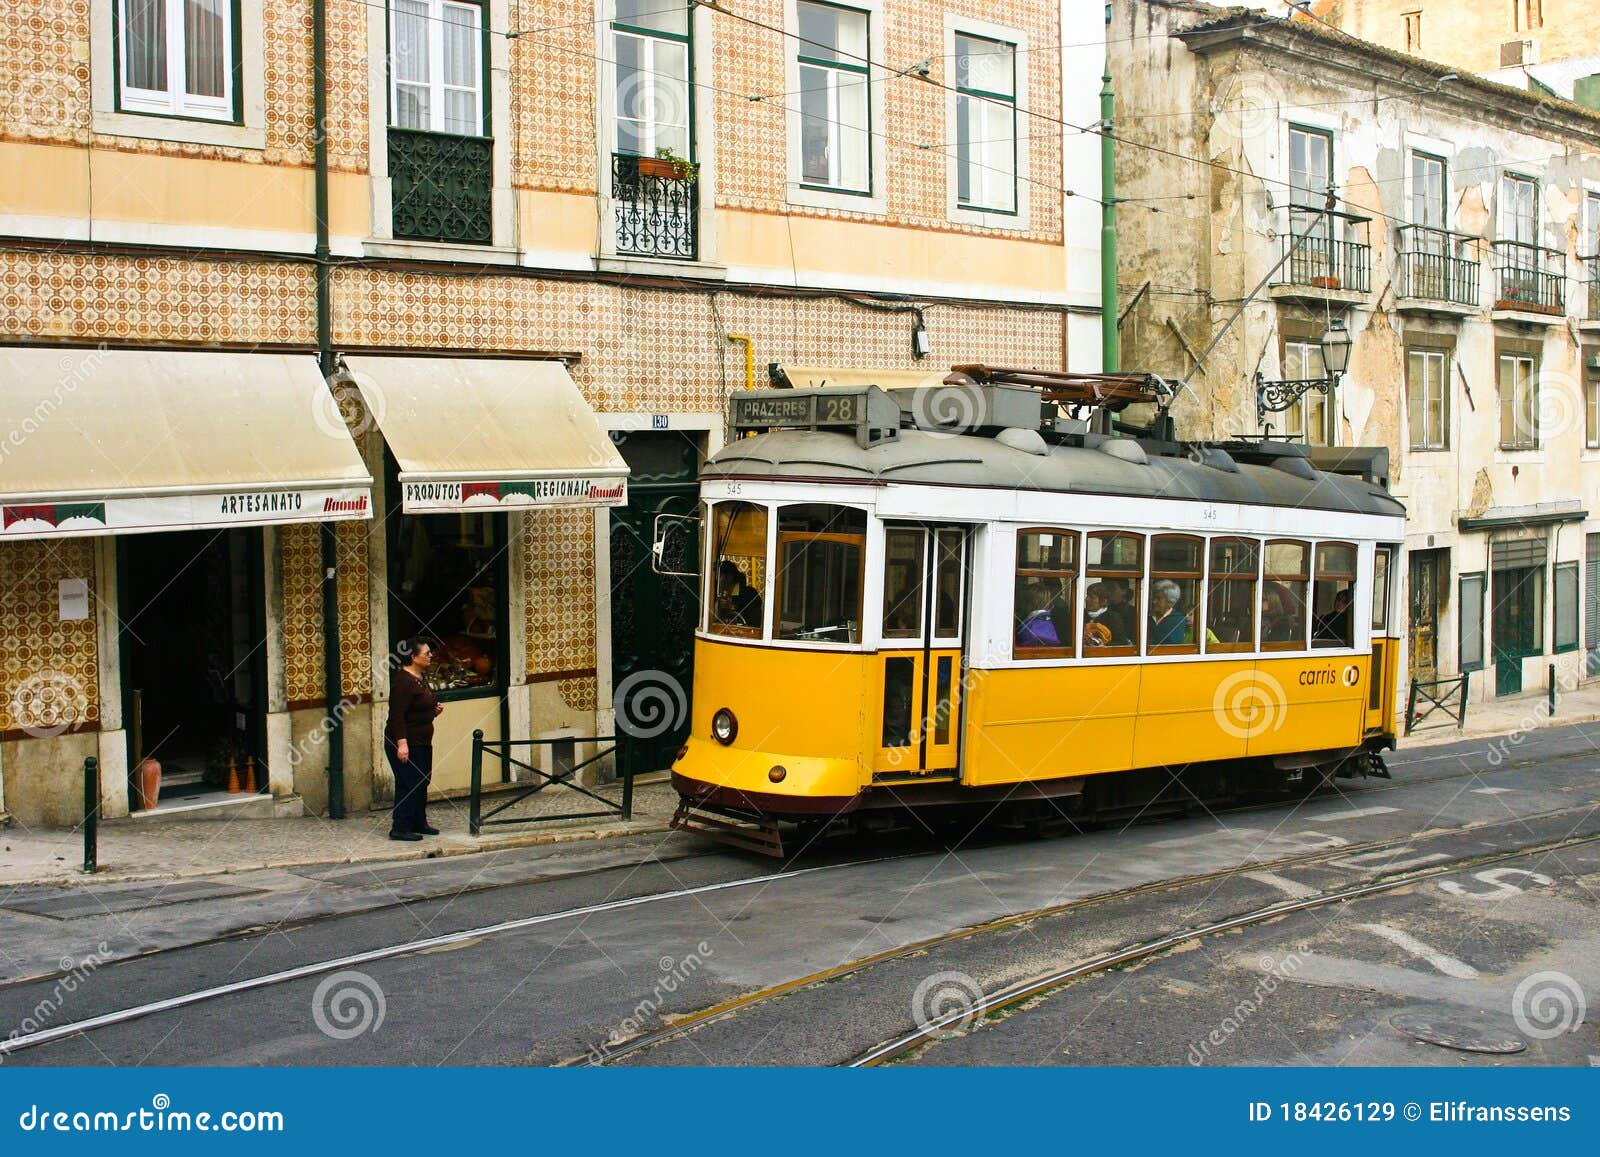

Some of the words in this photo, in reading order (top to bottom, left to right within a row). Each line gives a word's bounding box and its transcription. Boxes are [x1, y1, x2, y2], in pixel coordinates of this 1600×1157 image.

[743, 400, 807, 418] PRAZERES
[826, 399, 853, 422] 28
[653, 415, 668, 428] 130
[406, 483, 461, 501] PRODUTOS
[536, 479, 590, 498] REGIONAIS
[726, 483, 742, 495] 545
[221, 492, 302, 514] ARTESANATO
[1299, 663, 1336, 686] carris
